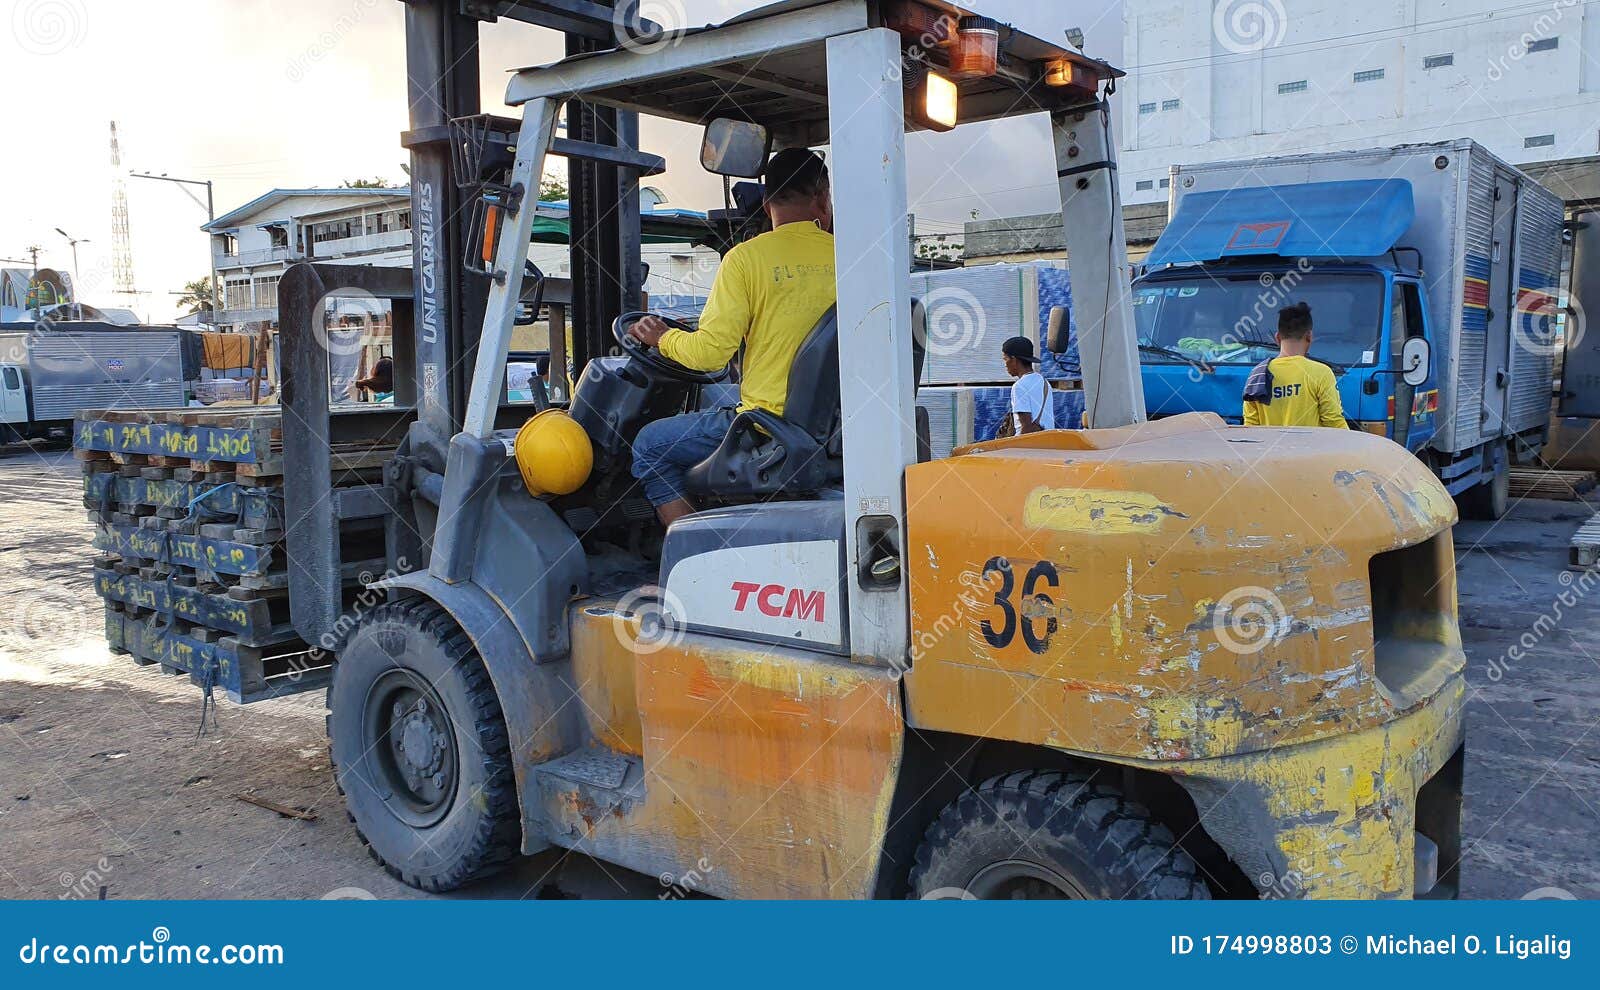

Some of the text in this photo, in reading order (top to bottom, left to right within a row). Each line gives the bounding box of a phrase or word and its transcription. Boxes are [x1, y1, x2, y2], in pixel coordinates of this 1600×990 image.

[1273, 384, 1301, 398] SIST
[731, 581, 826, 623] TCM
[980, 556, 1060, 655] 36
